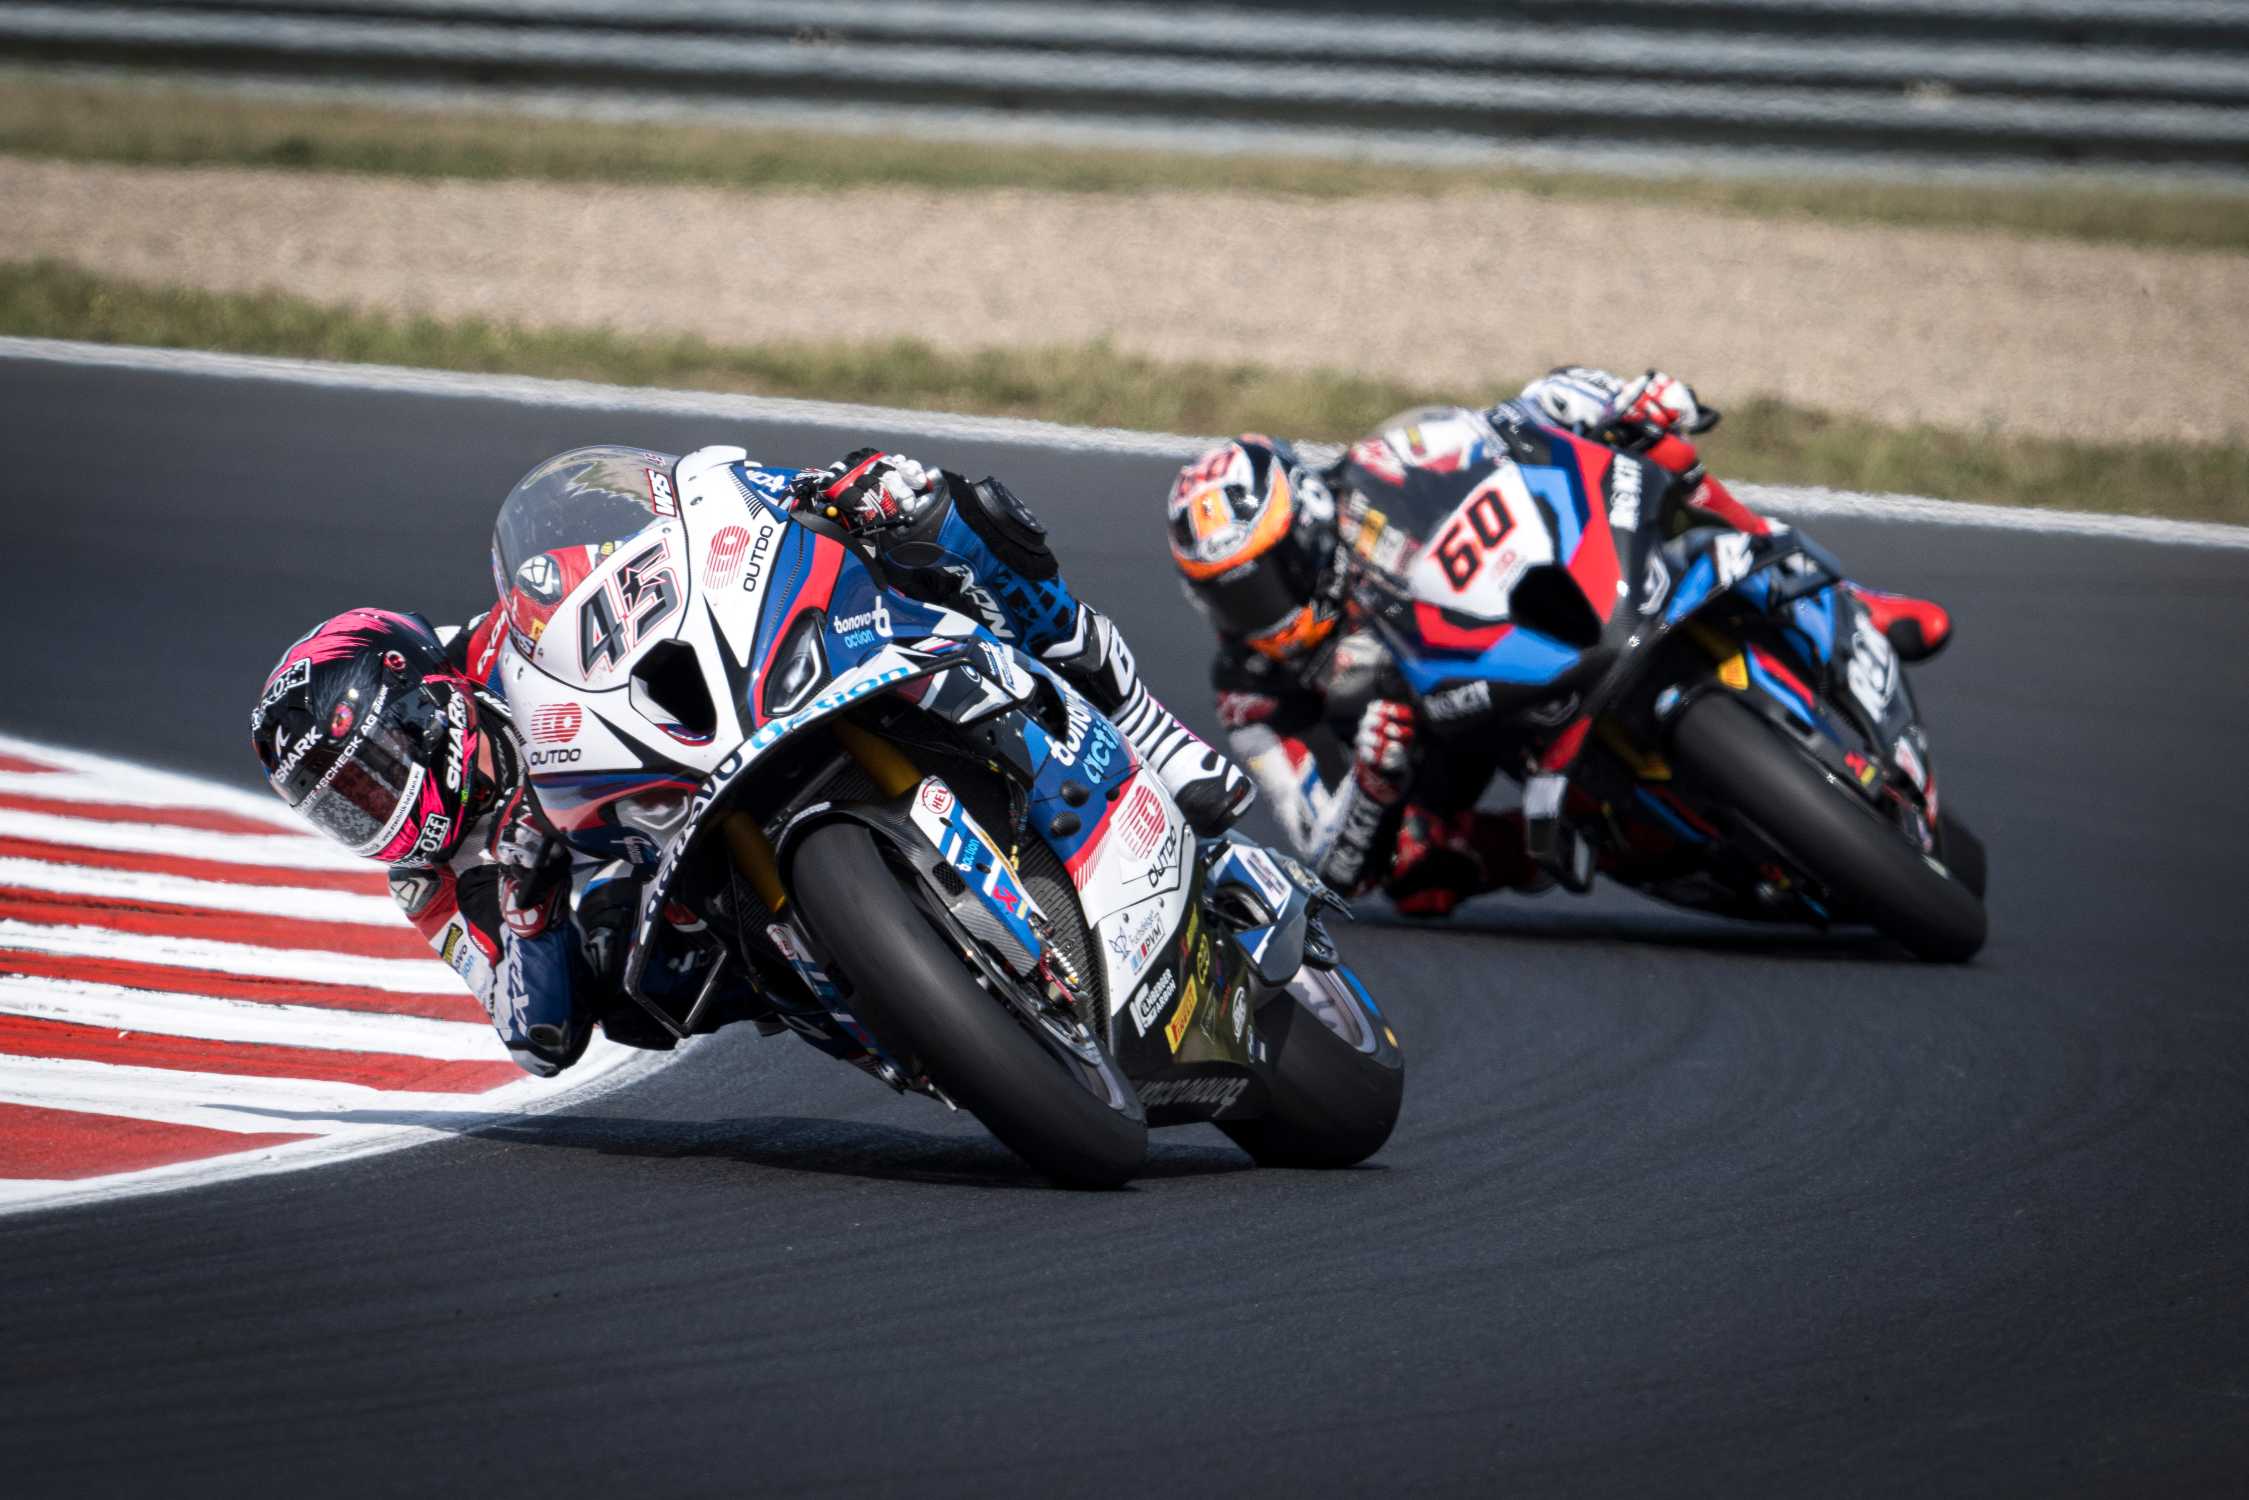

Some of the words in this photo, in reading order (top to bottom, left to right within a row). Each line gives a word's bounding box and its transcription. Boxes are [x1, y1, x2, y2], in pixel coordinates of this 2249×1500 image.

[743, 525, 773, 592] OUTDO
[1434, 489, 1516, 593] 60
[577, 538, 683, 680] 45
[834, 614, 871, 635] bonovo
[844, 629, 876, 649] action
[360, 714, 378, 736] AG
[447, 689, 467, 793] SHARK
[275, 725, 323, 783] SHARK
[531, 748, 581, 766] OUTDO
[931, 788, 948, 811] HEL
[1148, 826, 1178, 888] OUTDO
[1145, 921, 1162, 949] PVM
